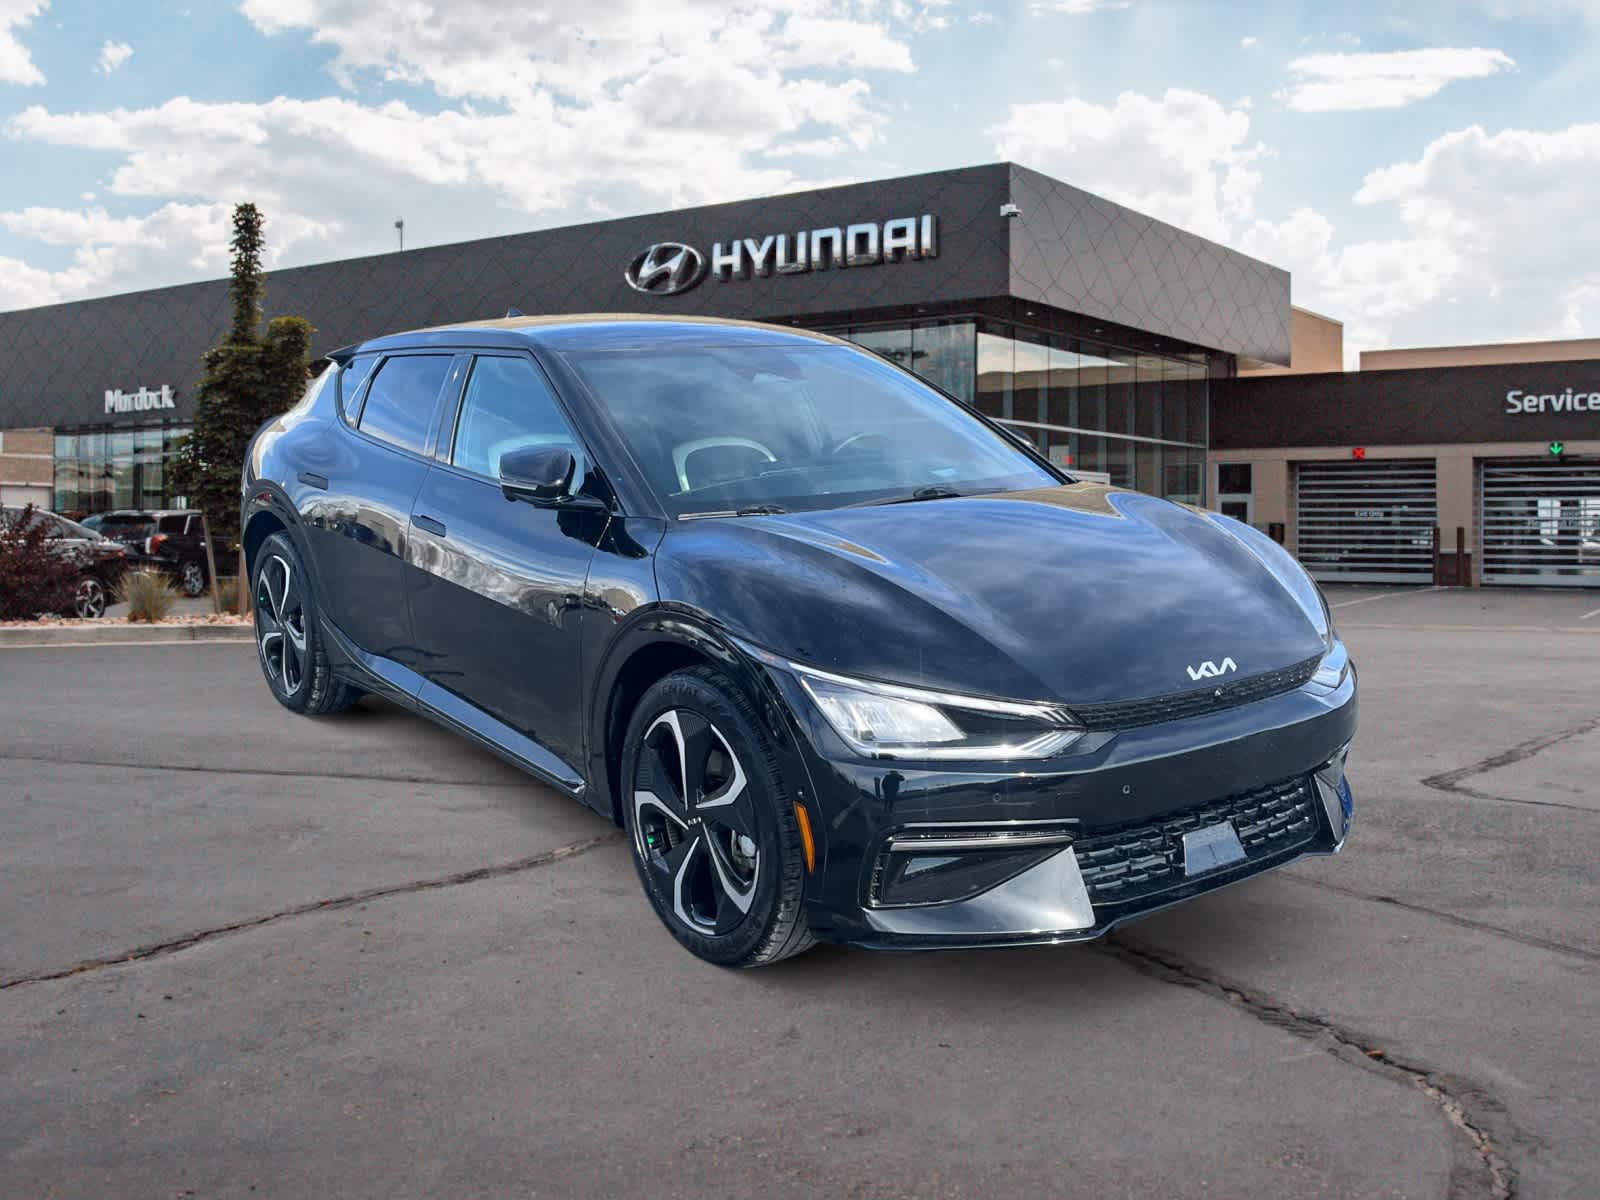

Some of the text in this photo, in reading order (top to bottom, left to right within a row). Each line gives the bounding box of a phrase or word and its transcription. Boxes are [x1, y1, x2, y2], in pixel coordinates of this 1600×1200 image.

[711, 214, 938, 282] HYUNDAI
[104, 384, 176, 414] Murdock
[1505, 387, 1600, 414] Service
[1186, 656, 1238, 681] KIA
